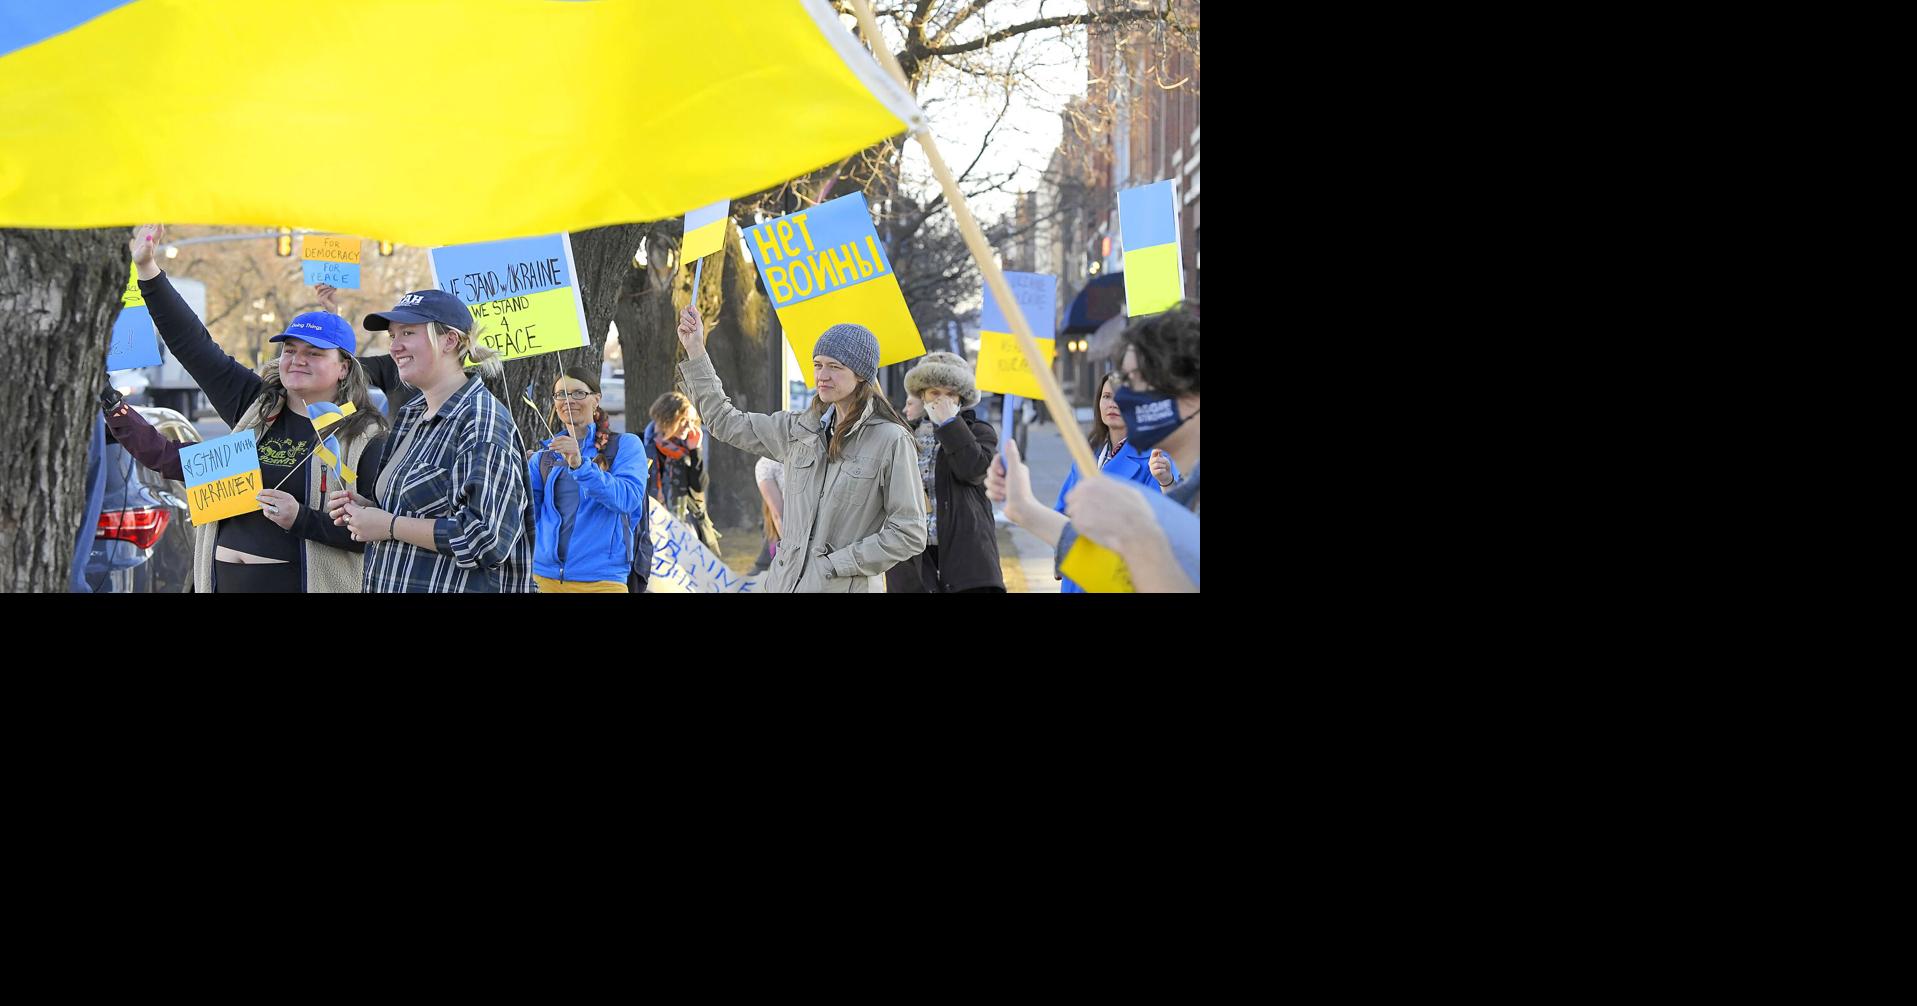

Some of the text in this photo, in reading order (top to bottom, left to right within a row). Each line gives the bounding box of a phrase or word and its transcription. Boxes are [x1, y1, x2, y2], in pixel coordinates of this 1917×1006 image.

[324, 238, 340, 248] FOR
[305, 248, 360, 261] DEMOCRACY
[324, 263, 340, 272] FOR
[765, 235, 885, 304] ВОЙНЫ
[311, 273, 349, 283] PEACE
[464, 271, 499, 302] STAND
[471, 296, 530, 319] WE STAND
[305, 323, 323, 331] Things
[500, 316, 509, 332] 4
[483, 325, 542, 357] PEACE
[193, 444, 231, 478] STAND
[194, 477, 248, 511] UKRAINE
